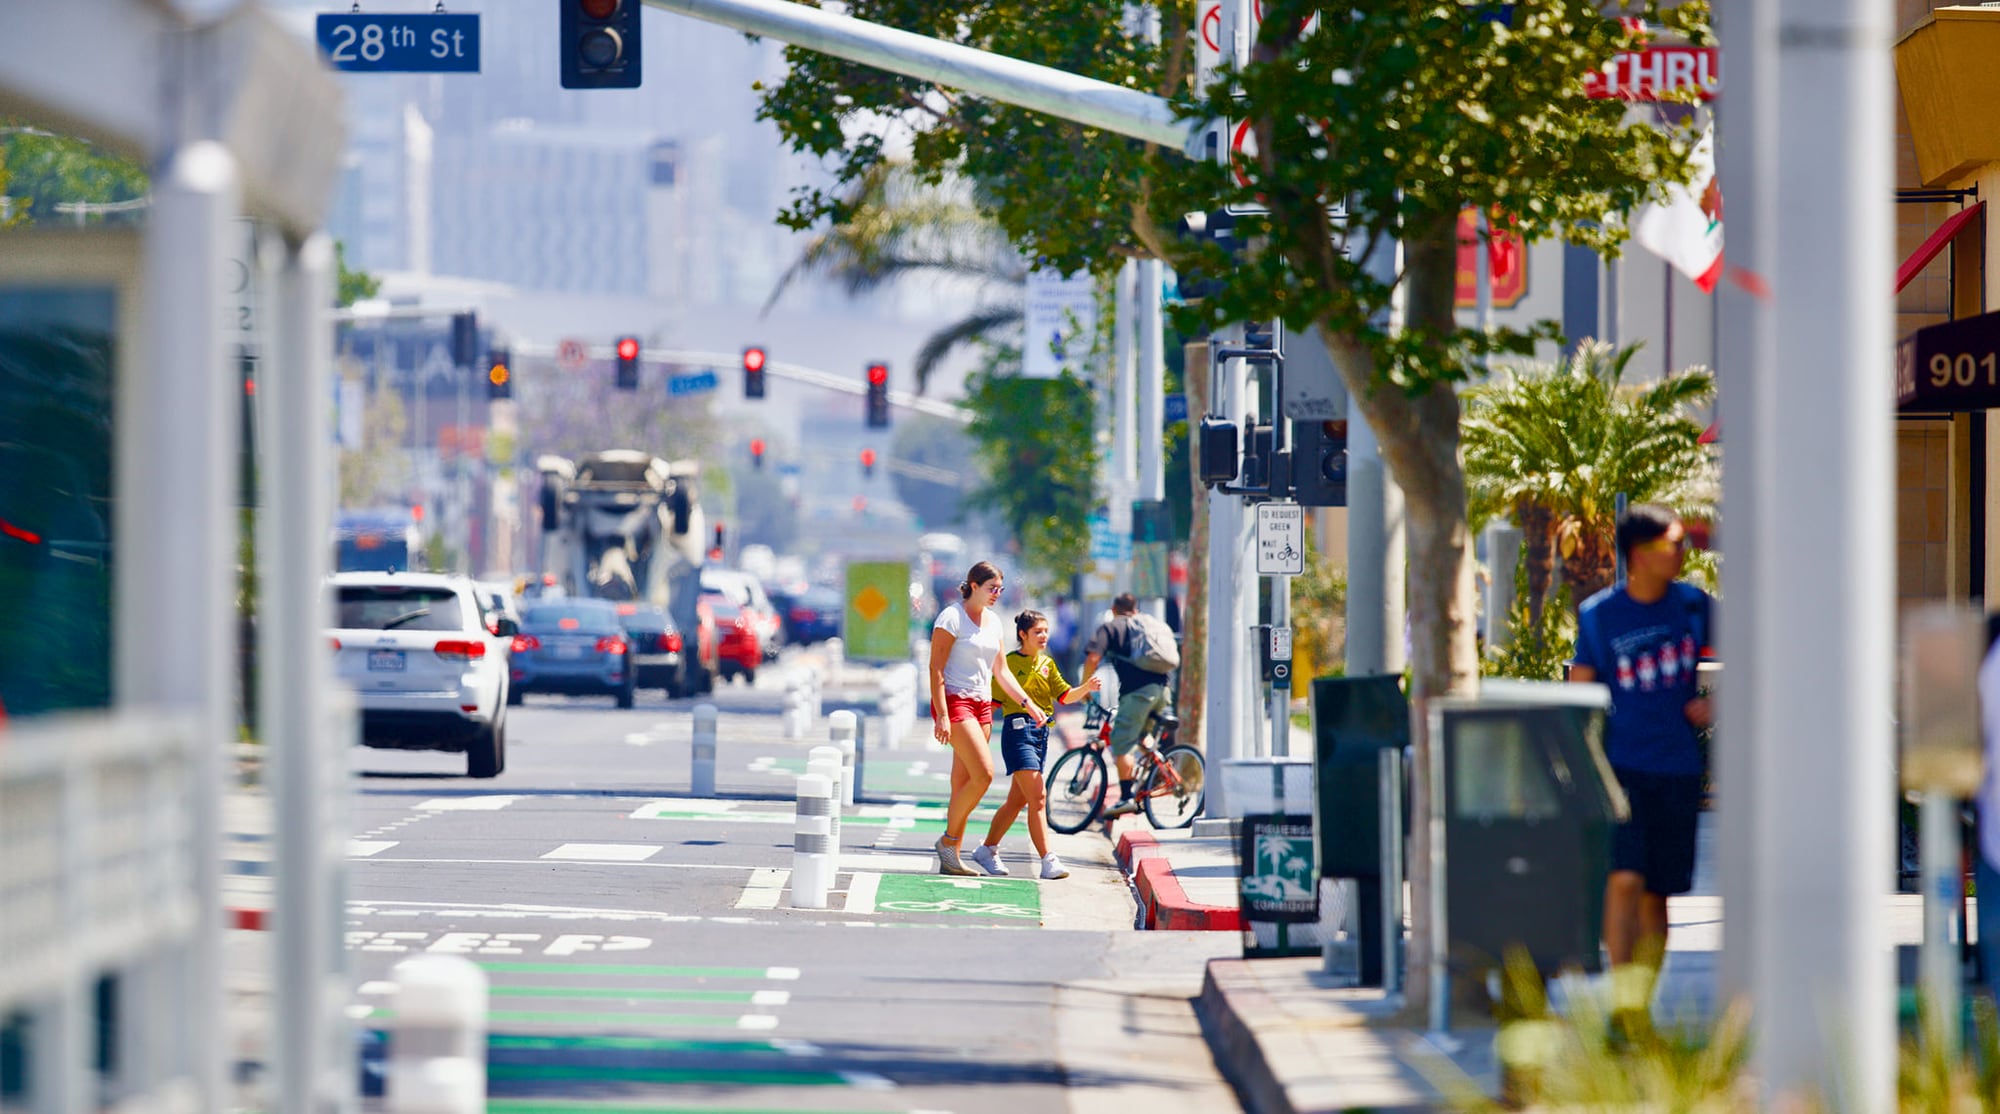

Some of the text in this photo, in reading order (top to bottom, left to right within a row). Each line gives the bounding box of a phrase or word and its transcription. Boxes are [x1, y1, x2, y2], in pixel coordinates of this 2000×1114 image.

[332, 24, 465, 62] 28th St
[1929, 351, 1996, 389] 901
[1261, 510, 1299, 518] TO REQUEST
[1270, 523, 1290, 531] GREEN
[1262, 540, 1276, 548] WAIT
[1265, 552, 1274, 560] ON
[344, 930, 654, 956] EEP
